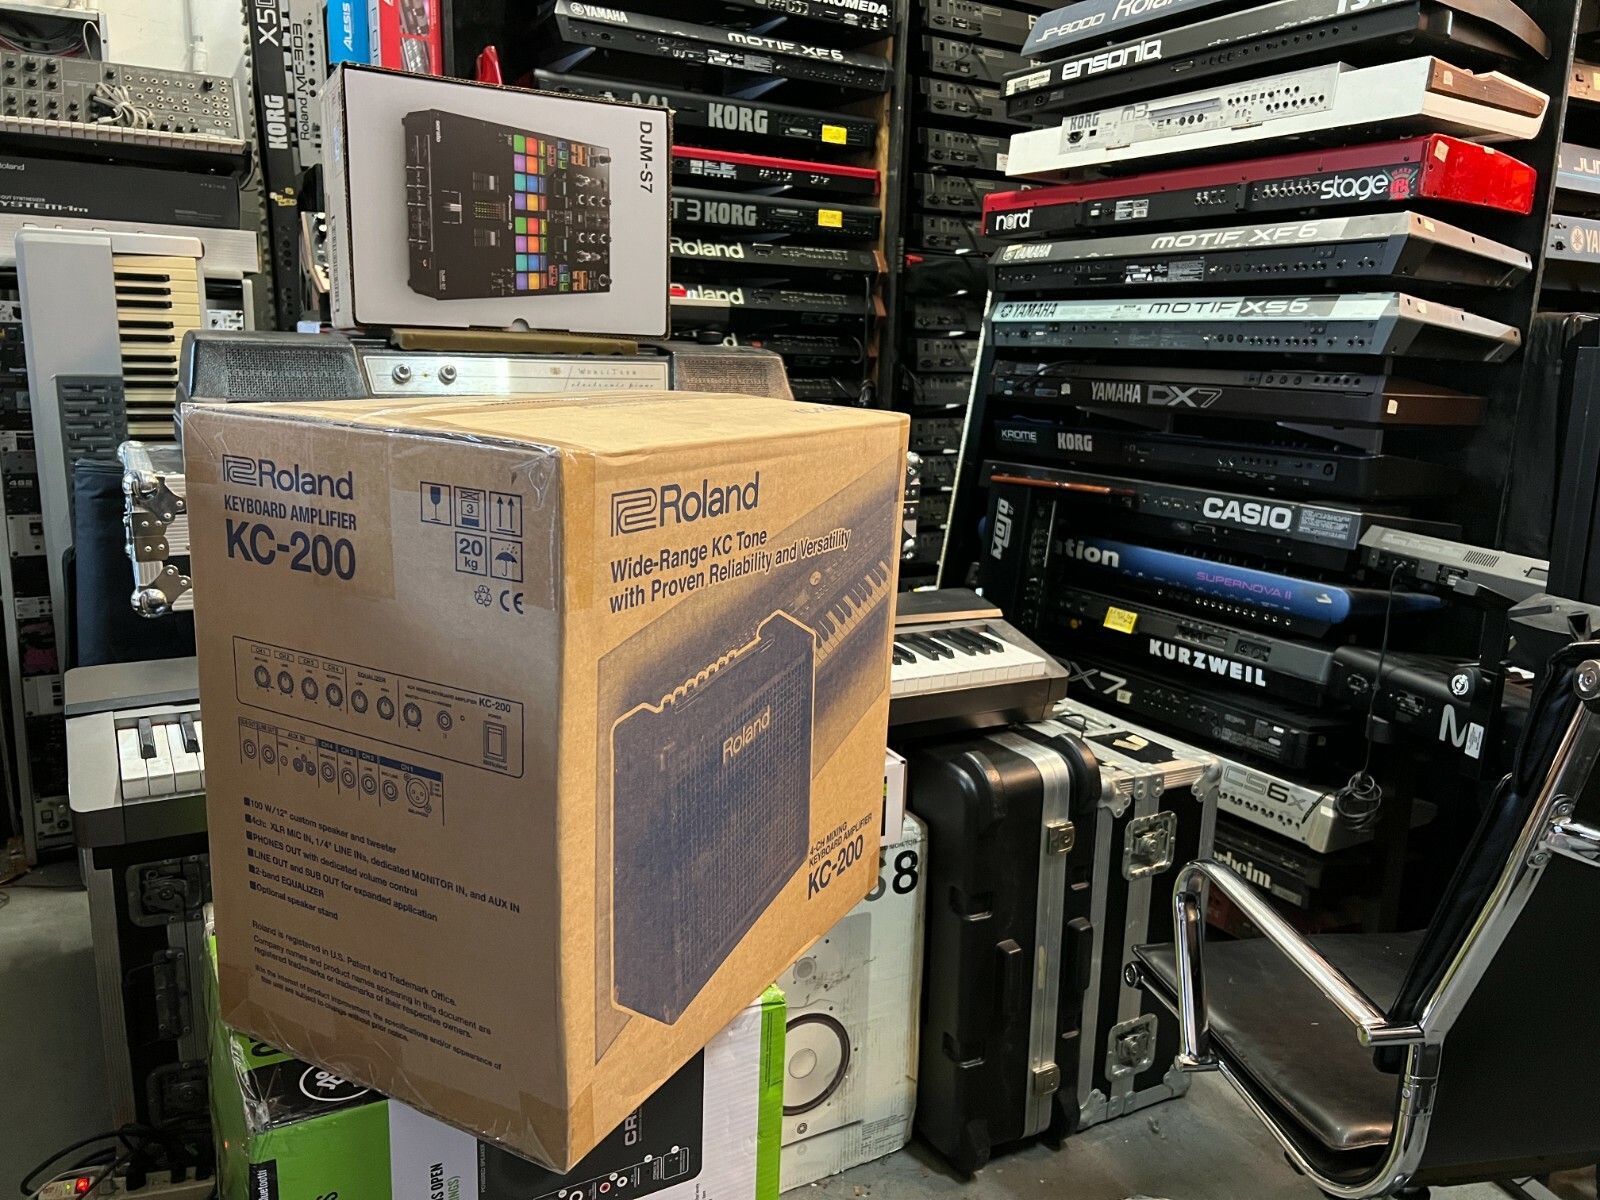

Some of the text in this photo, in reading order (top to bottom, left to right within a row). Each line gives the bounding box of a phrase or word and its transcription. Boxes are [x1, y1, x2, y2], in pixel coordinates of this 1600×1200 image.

[343, 2, 354, 52] ALESIS
[584, 6, 628, 23] YAMAHA
[1036, 13, 1105, 42] JP-8000
[727, 32, 844, 60] MOTIF XF6
[1061, 40, 1162, 80] ensoniq
[293, 23, 310, 140] Roland MC-303
[265, 95, 288, 149] KORG
[708, 103, 768, 134] KORG
[1070, 103, 1149, 131] KORG M3
[0, 162, 25, 171] oland
[639, 121, 653, 193] DJM-S7
[1320, 174, 1388, 200] stage
[671, 198, 758, 226] T3 KORG
[996, 210, 1030, 231] nord
[670, 237, 744, 259] Roland
[1151, 222, 1320, 249] MOTIF XF6
[1012, 298, 1311, 318] YAMAHA MOTIF XS6
[1091, 381, 1223, 408] YAMAHA DX7
[1001, 429, 1037, 441] KROME
[1058, 432, 1093, 452] KORG
[258, 459, 353, 500] Roland
[224, 494, 357, 531] KEYBOARD AMPLIFIER
[465, 503, 475, 515] 3
[660, 471, 759, 527] Roland
[1203, 497, 1292, 530] CASIO
[225, 519, 356, 581] KC-200
[459, 539, 483, 558] 20
[464, 558, 478, 571] kg
[611, 530, 767, 583] Wide-Range KC Tone
[609, 529, 850, 613] with Proven Reliability and Versatility
[1196, 572, 1293, 601] SUPERNOVA II
[357, 671, 386, 684] EQUALIZER
[1149, 639, 1266, 687] KURZWEIL
[479, 697, 512, 713] KC-200
[723, 705, 770, 764] Roland
[251, 800, 263, 810] 100
[290, 813, 316, 828] custom
[319, 823, 348, 839] speaker
[351, 834, 364, 844] and
[367, 838, 396, 853] tweeter
[809, 812, 872, 868] KEYBOARD AMPLIFIER
[810, 821, 847, 855] 4-CH MIXING
[252, 832, 417, 896] PHONES OUT with dedicated volume control
[271, 822, 285, 834] XLR
[287, 828, 301, 840] MIC
[303, 834, 314, 845] IN,
[334, 844, 352, 857] LINE
[371, 857, 410, 876] dedicated
[412, 870, 453, 890] MONITOR
[456, 885, 468, 897] IN,
[470, 890, 485, 902] and
[488, 896, 507, 909] AUX
[510, 902, 520, 913] IN
[808, 834, 863, 900] KC-200
[254, 850, 438, 921] LINE OUT and SUB OUT for expanded application
[255, 867, 324, 898] 2-band EQUALIZER
[256, 883, 338, 920] Optional speaker stand
[252, 920, 276, 936] Roland
[286, 934, 320, 953] registered
[322, 947, 329, 957] in
[347, 956, 371, 972] Patent
[373, 968, 386, 979] and
[388, 972, 429, 995] Trademark
[431, 989, 457, 1006] Office.
[253, 935, 491, 1035] Company names and product names appearing in this document are
[254, 946, 286, 964] registered
[287, 958, 326, 980] trademarks
[336, 977, 374, 999] trademarks
[376, 994, 384, 1002] of
[385, 997, 401, 1009] their
[402, 1005, 441, 1027] respective
[442, 1022, 472, 1039] owners.
[307, 986, 330, 1000] product
[385, 1018, 428, 1041] specifications
[429, 1036, 452, 1050] and/or
[452, 1046, 493, 1068] appearance
[493, 1063, 502, 1071] of
[430, 1162, 443, 1191] OPEN
